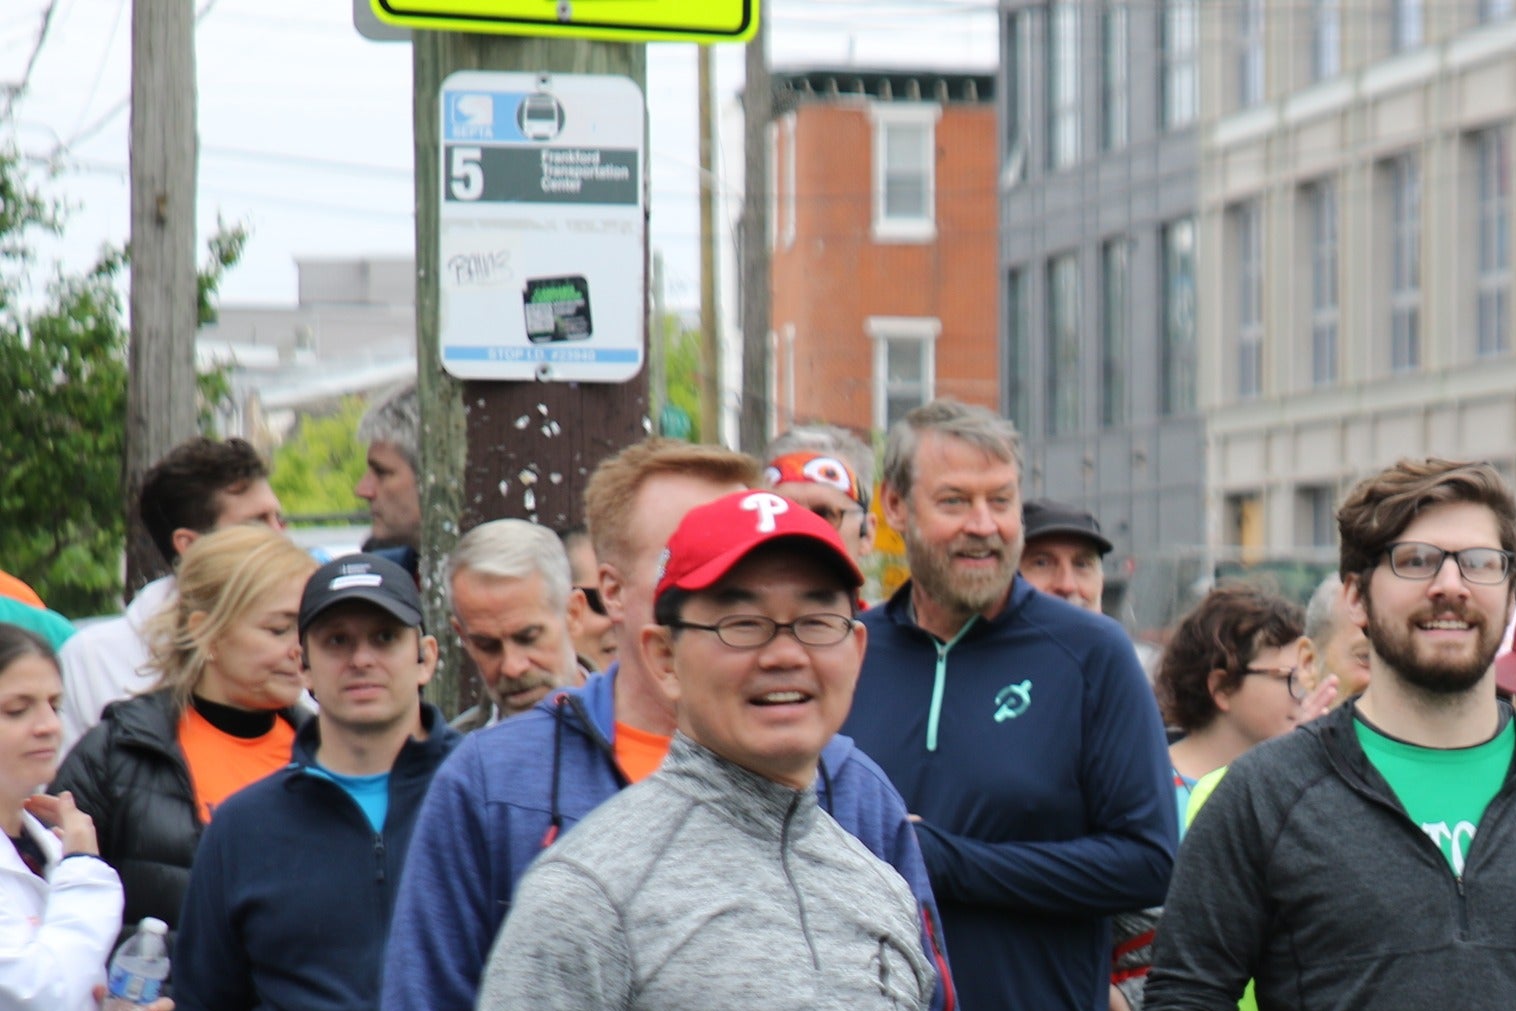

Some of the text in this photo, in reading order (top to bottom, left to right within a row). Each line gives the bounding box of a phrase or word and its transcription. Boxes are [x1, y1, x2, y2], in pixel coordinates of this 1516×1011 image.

[452, 125, 494, 139] SEPTA
[541, 149, 600, 165] Frankford
[451, 147, 484, 201] 5
[542, 164, 630, 181] Transportation
[541, 178, 583, 194] Center
[740, 492, 789, 533] P
